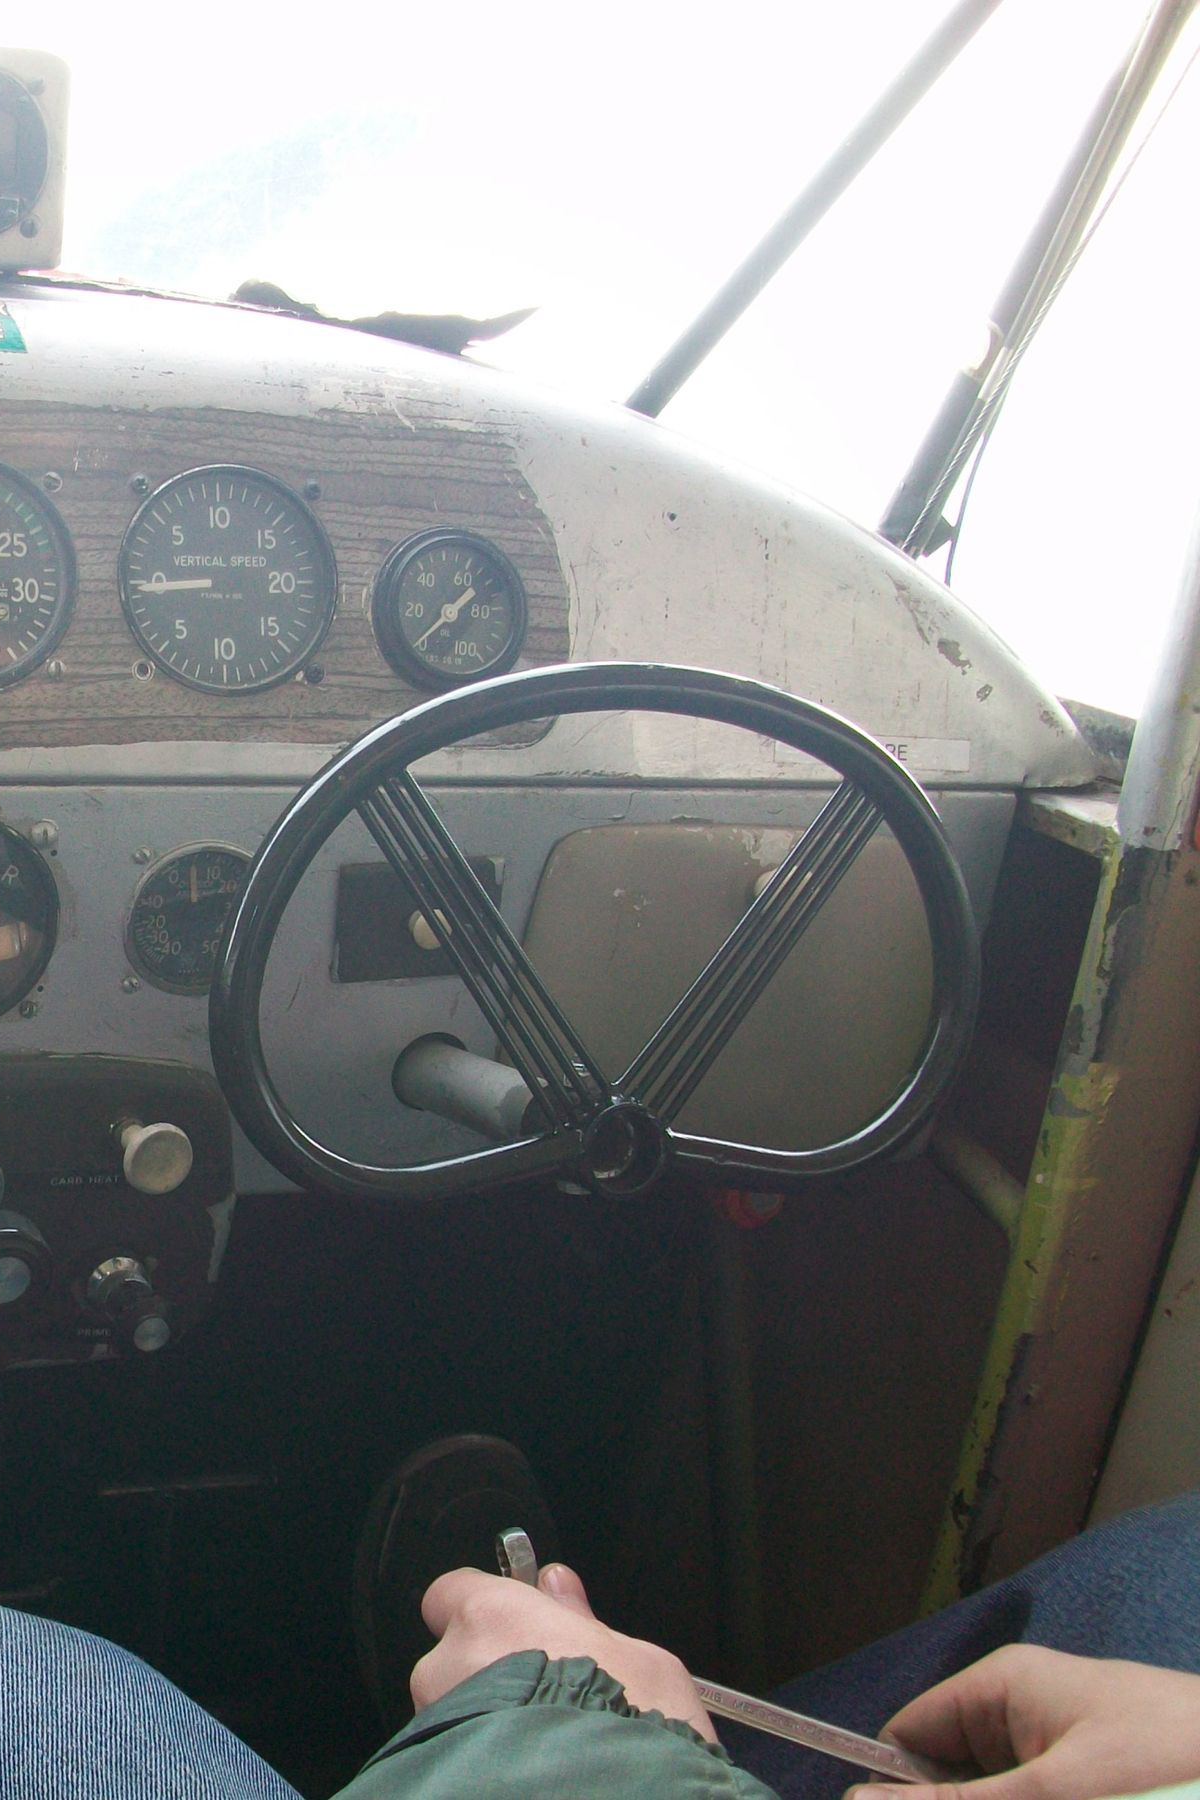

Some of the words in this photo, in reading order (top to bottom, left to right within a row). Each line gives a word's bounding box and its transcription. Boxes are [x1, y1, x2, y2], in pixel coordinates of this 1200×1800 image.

[209, 506, 231, 529] 10
[171, 525, 184, 546] 5
[257, 529, 277, 550] 15
[173, 556, 226, 568] VERTICAL
[230, 556, 268, 568] SPEED
[151, 572, 167, 595] 0
[268, 571, 296, 594] 20
[416, 574, 435, 588] 40
[454, 572, 473, 587] 60
[11, 577, 40, 603] 30
[405, 602, 424, 618] 20
[470, 603, 490, 620] 80
[175, 619, 188, 640] 5
[260, 616, 280, 637] 15
[214, 637, 236, 661] 10
[454, 640, 477, 657] 100
[0, 865, 19, 885] R
[168, 870, 179, 884] 0
[206, 866, 221, 879] 10
[218, 880, 236, 894] 20
[201, 939, 219, 954] 50
[50, 1175, 83, 1186] CARB
[89, 1175, 119, 1184] HEAT
